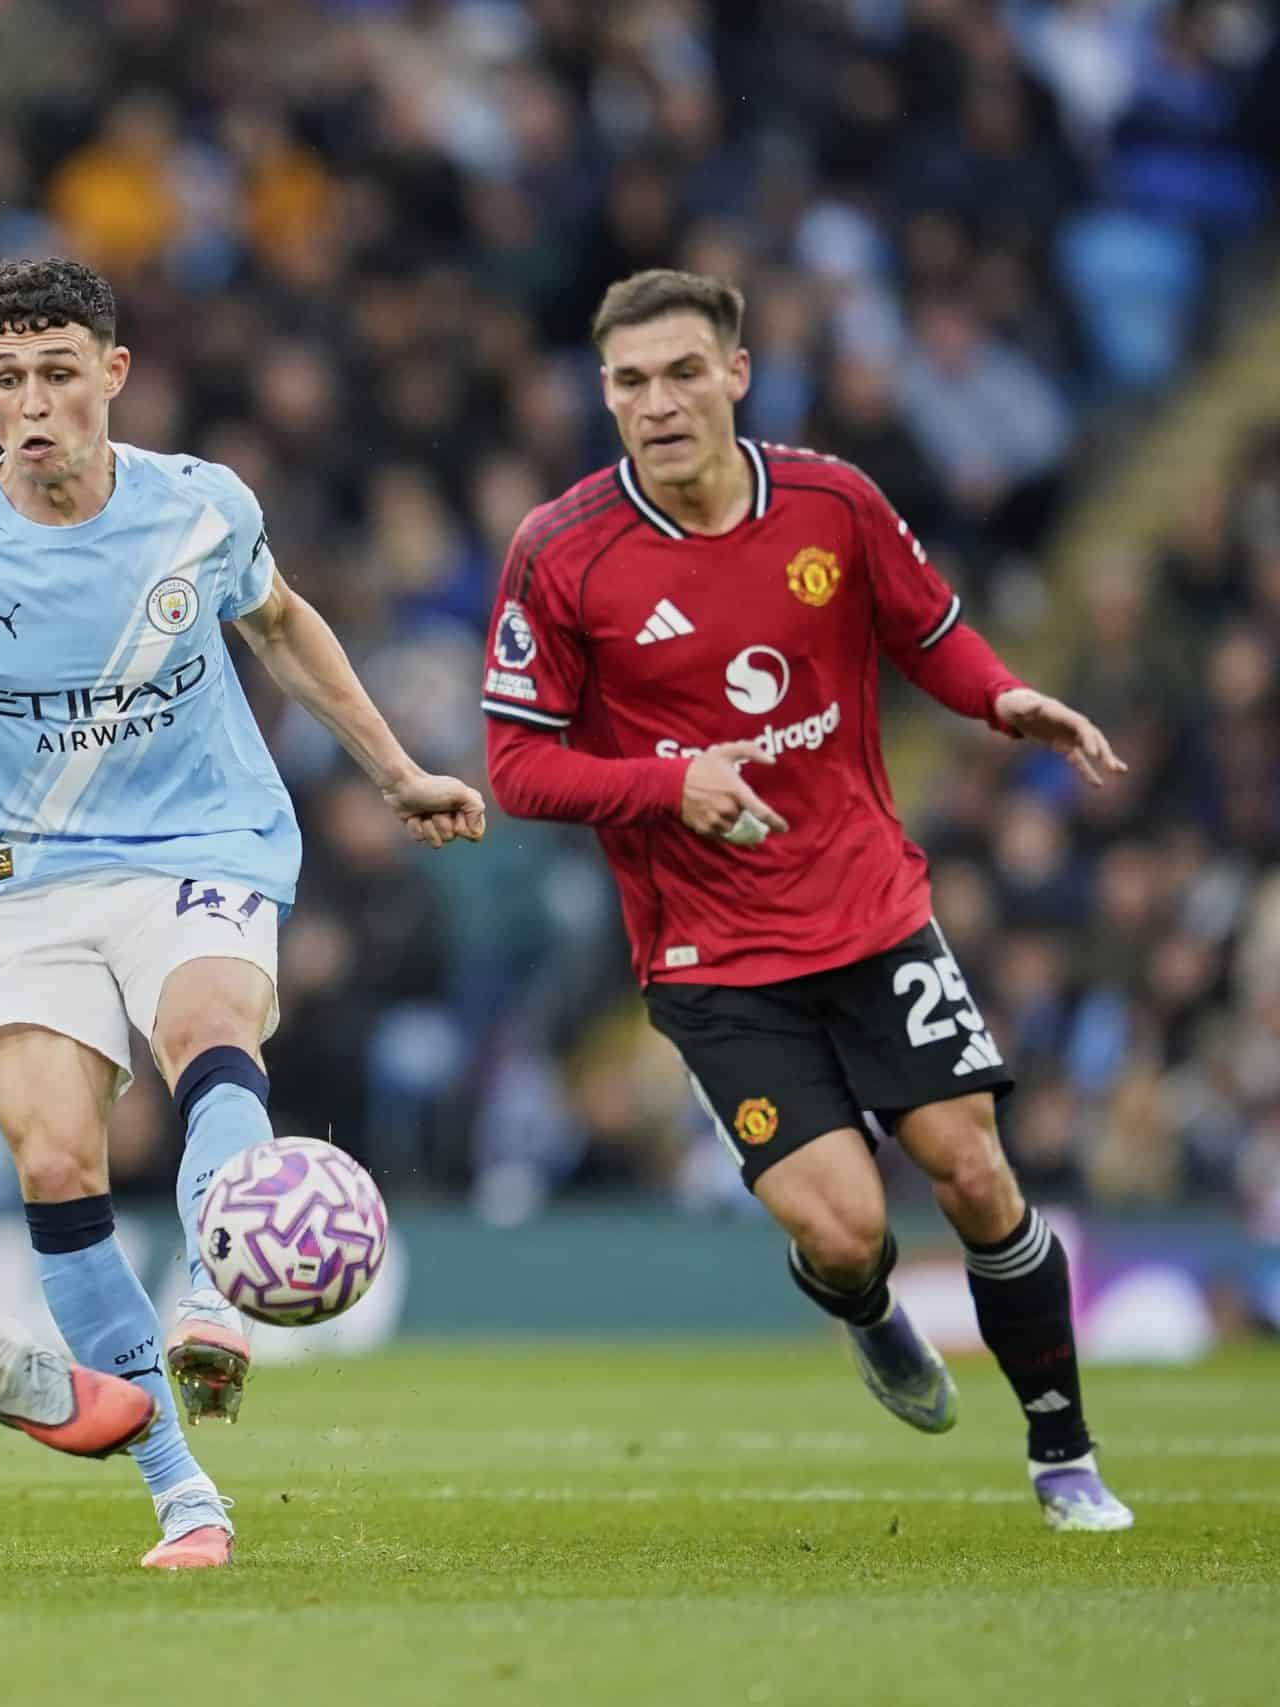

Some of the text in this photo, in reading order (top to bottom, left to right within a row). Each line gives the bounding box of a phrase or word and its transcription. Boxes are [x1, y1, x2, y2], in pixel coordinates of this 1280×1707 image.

[36, 711, 175, 753] AIRWAYS
[893, 957, 984, 1048] 25
[114, 1335, 154, 1366] CITY
